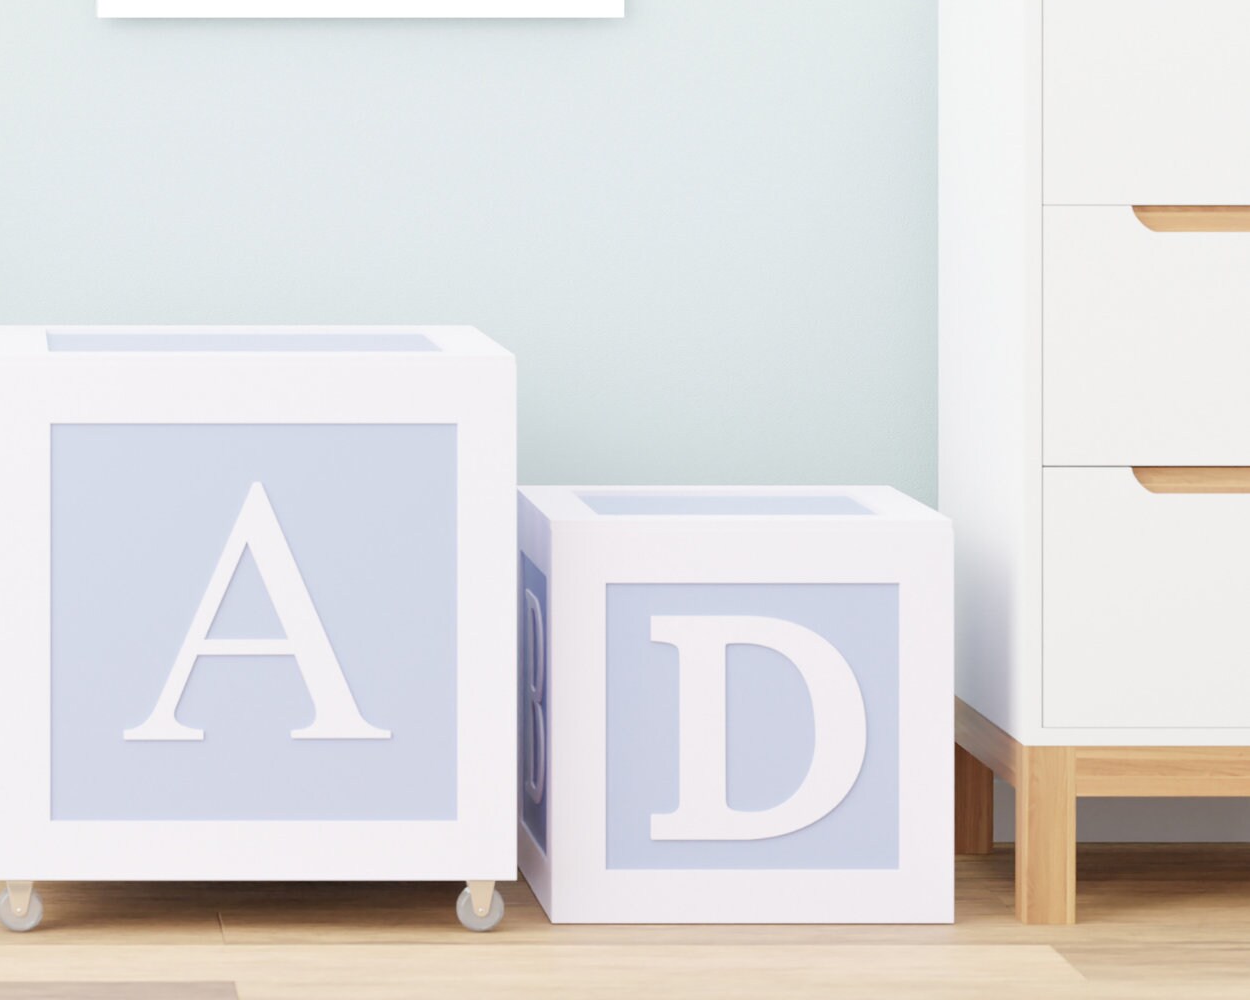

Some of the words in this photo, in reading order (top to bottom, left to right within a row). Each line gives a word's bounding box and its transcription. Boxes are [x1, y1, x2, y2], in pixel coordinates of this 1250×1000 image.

[123, 481, 391, 740] A
[524, 588, 546, 804] B
[650, 615, 867, 840] D
